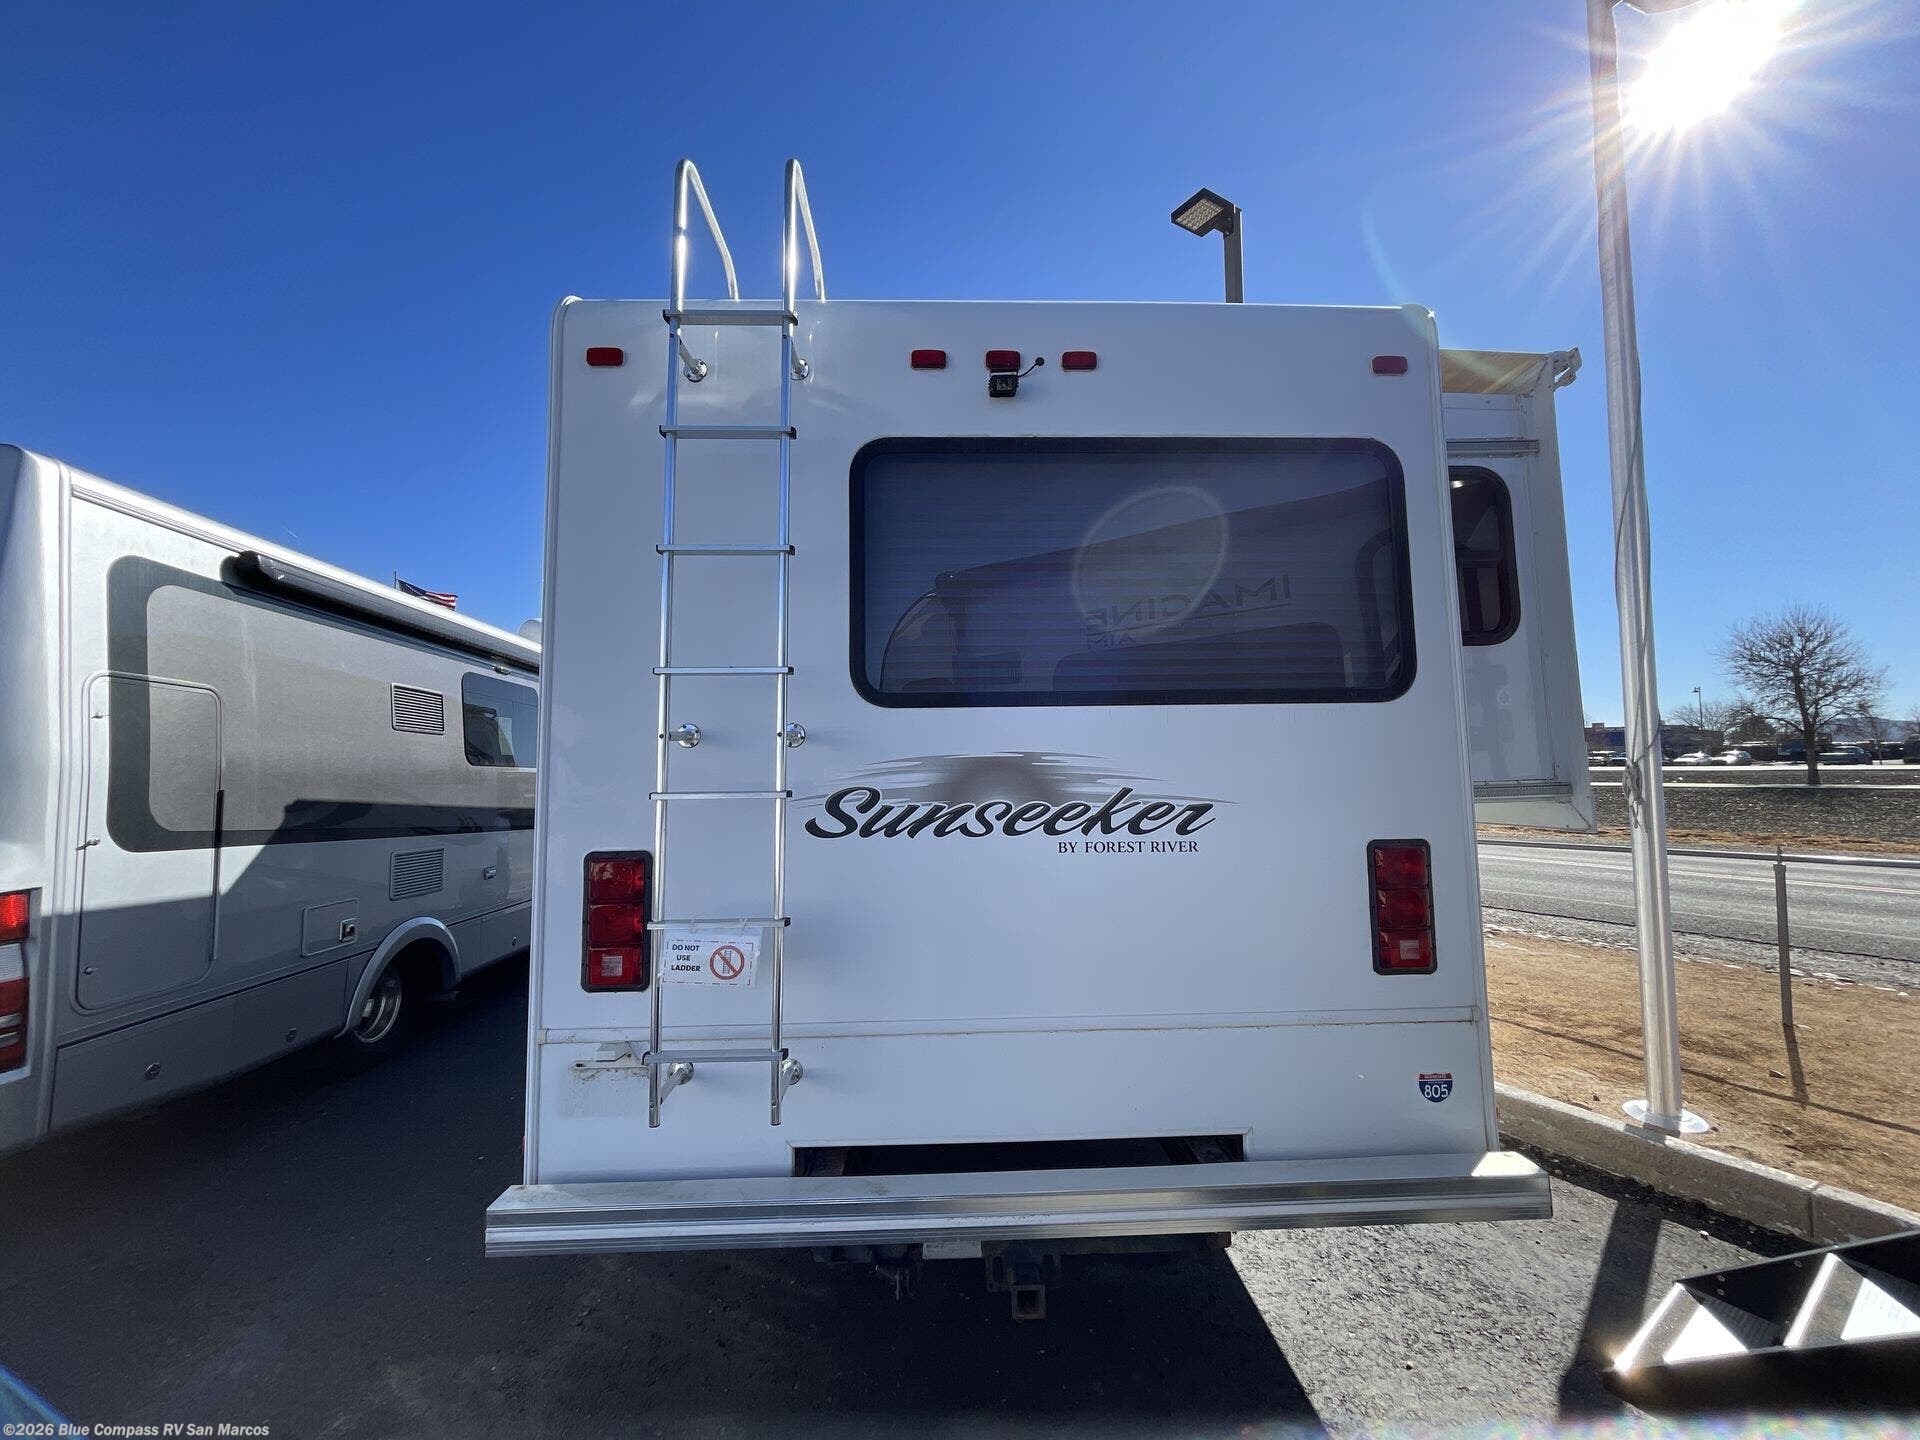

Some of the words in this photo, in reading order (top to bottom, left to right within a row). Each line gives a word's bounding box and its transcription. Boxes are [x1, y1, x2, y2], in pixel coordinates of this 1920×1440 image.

[805, 787, 1216, 839] Sunseeker
[1058, 841, 1077, 854] BY
[1085, 840, 1145, 853] FOREST
[1150, 839, 1198, 853] RIVER
[671, 964, 701, 972] LADDER
[1424, 1084, 1449, 1098] 805
